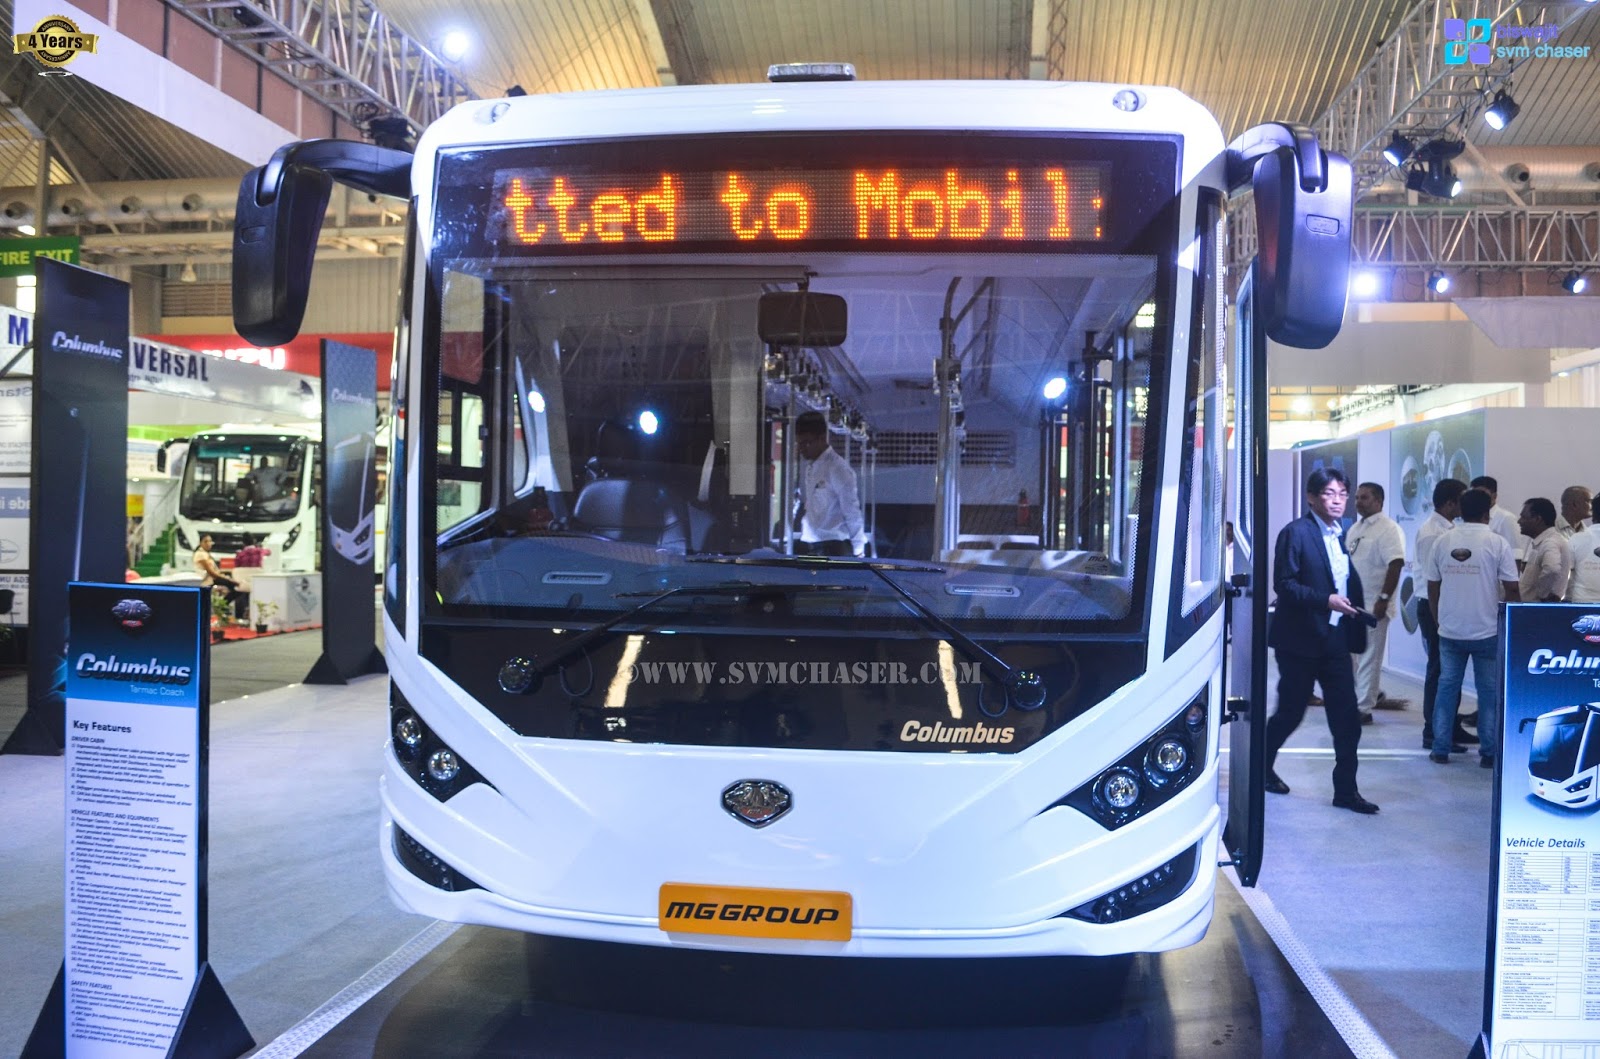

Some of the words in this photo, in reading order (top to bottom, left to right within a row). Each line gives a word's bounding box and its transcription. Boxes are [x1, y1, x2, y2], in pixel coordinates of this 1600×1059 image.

[505, 175, 675, 242] tted
[721, 174, 808, 239] to
[855, 171, 1101, 238] Mobil
[0, 250, 30, 266] IRE
[52, 331, 123, 362] Columbus
[76, 652, 191, 685] Columbus
[130, 685, 158, 695] Tarmac
[160, 686, 185, 697] Coach
[73, 720, 89, 731] Key
[92, 721, 132, 733] Features
[900, 720, 1015, 744] Columbus
[1506, 837, 1545, 848] Vehicle
[1548, 838, 1585, 848] Details
